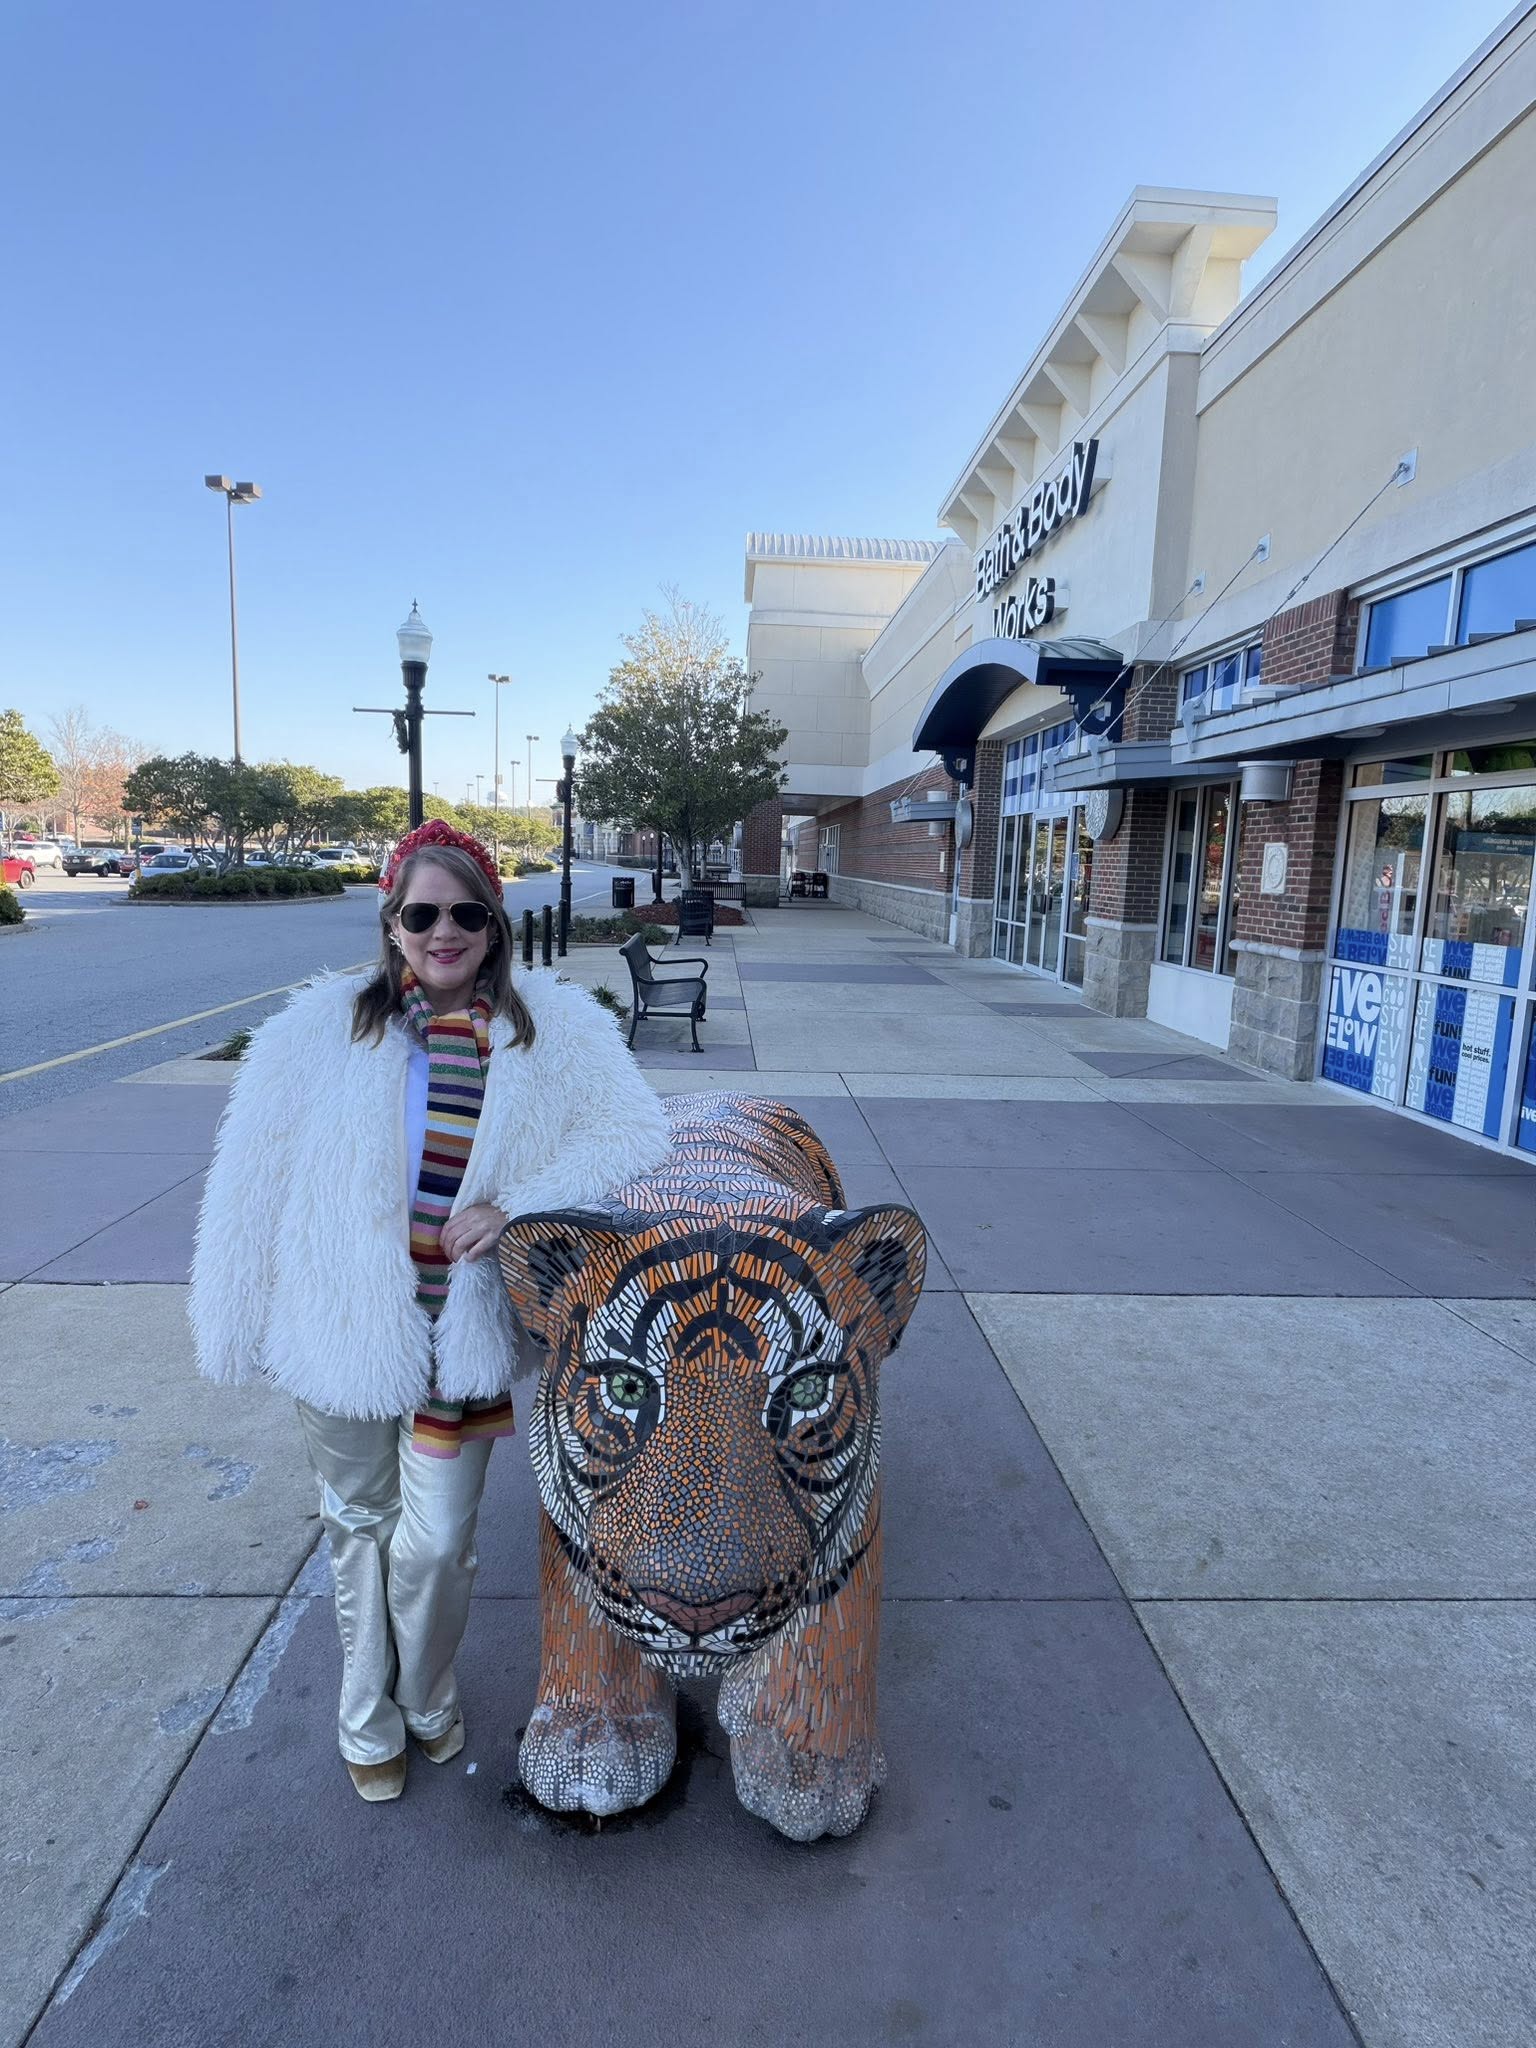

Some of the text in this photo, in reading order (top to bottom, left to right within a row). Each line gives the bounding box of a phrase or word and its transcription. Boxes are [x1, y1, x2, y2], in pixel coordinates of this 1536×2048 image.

[974, 439, 1099, 603] Bath & Body
[992, 577, 1055, 639] Works
[1328, 967, 1381, 1022] ive
[1326, 1014, 1378, 1057] ELOW
[1462, 1043, 1491, 1057] hot stuff.
[1521, 1105, 1536, 1122] ive
